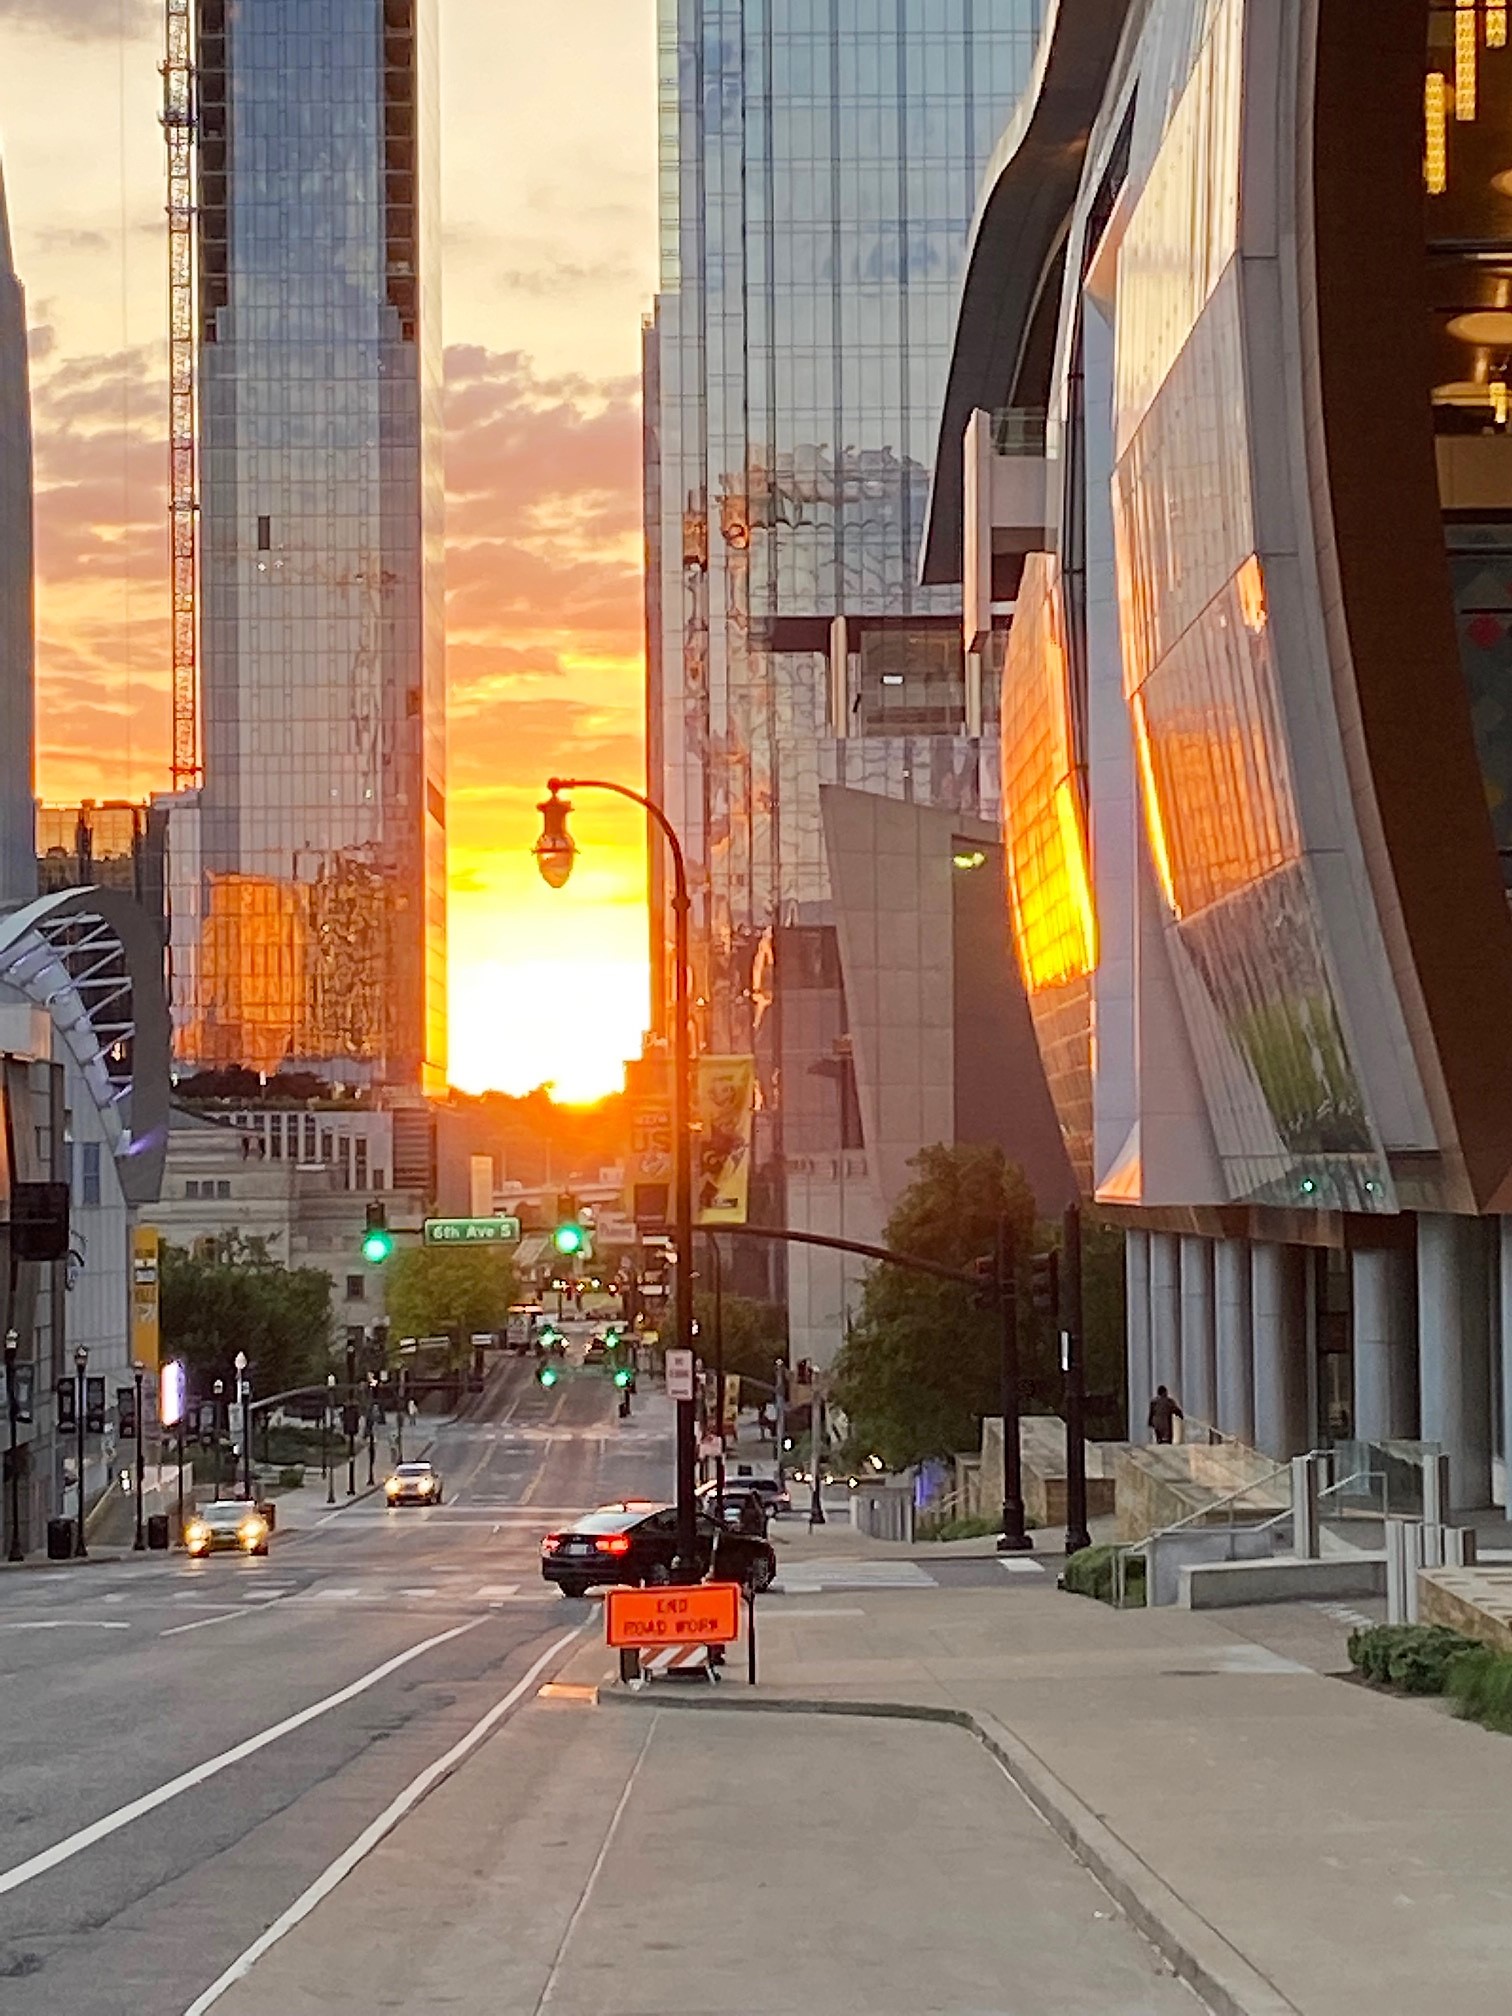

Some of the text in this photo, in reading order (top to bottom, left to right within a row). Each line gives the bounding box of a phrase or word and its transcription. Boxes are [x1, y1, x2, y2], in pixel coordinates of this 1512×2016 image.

[433, 1223, 511, 1239] 6th Ave S
[657, 1599, 687, 1614] END
[624, 1617, 718, 1636] ROAD WORK
